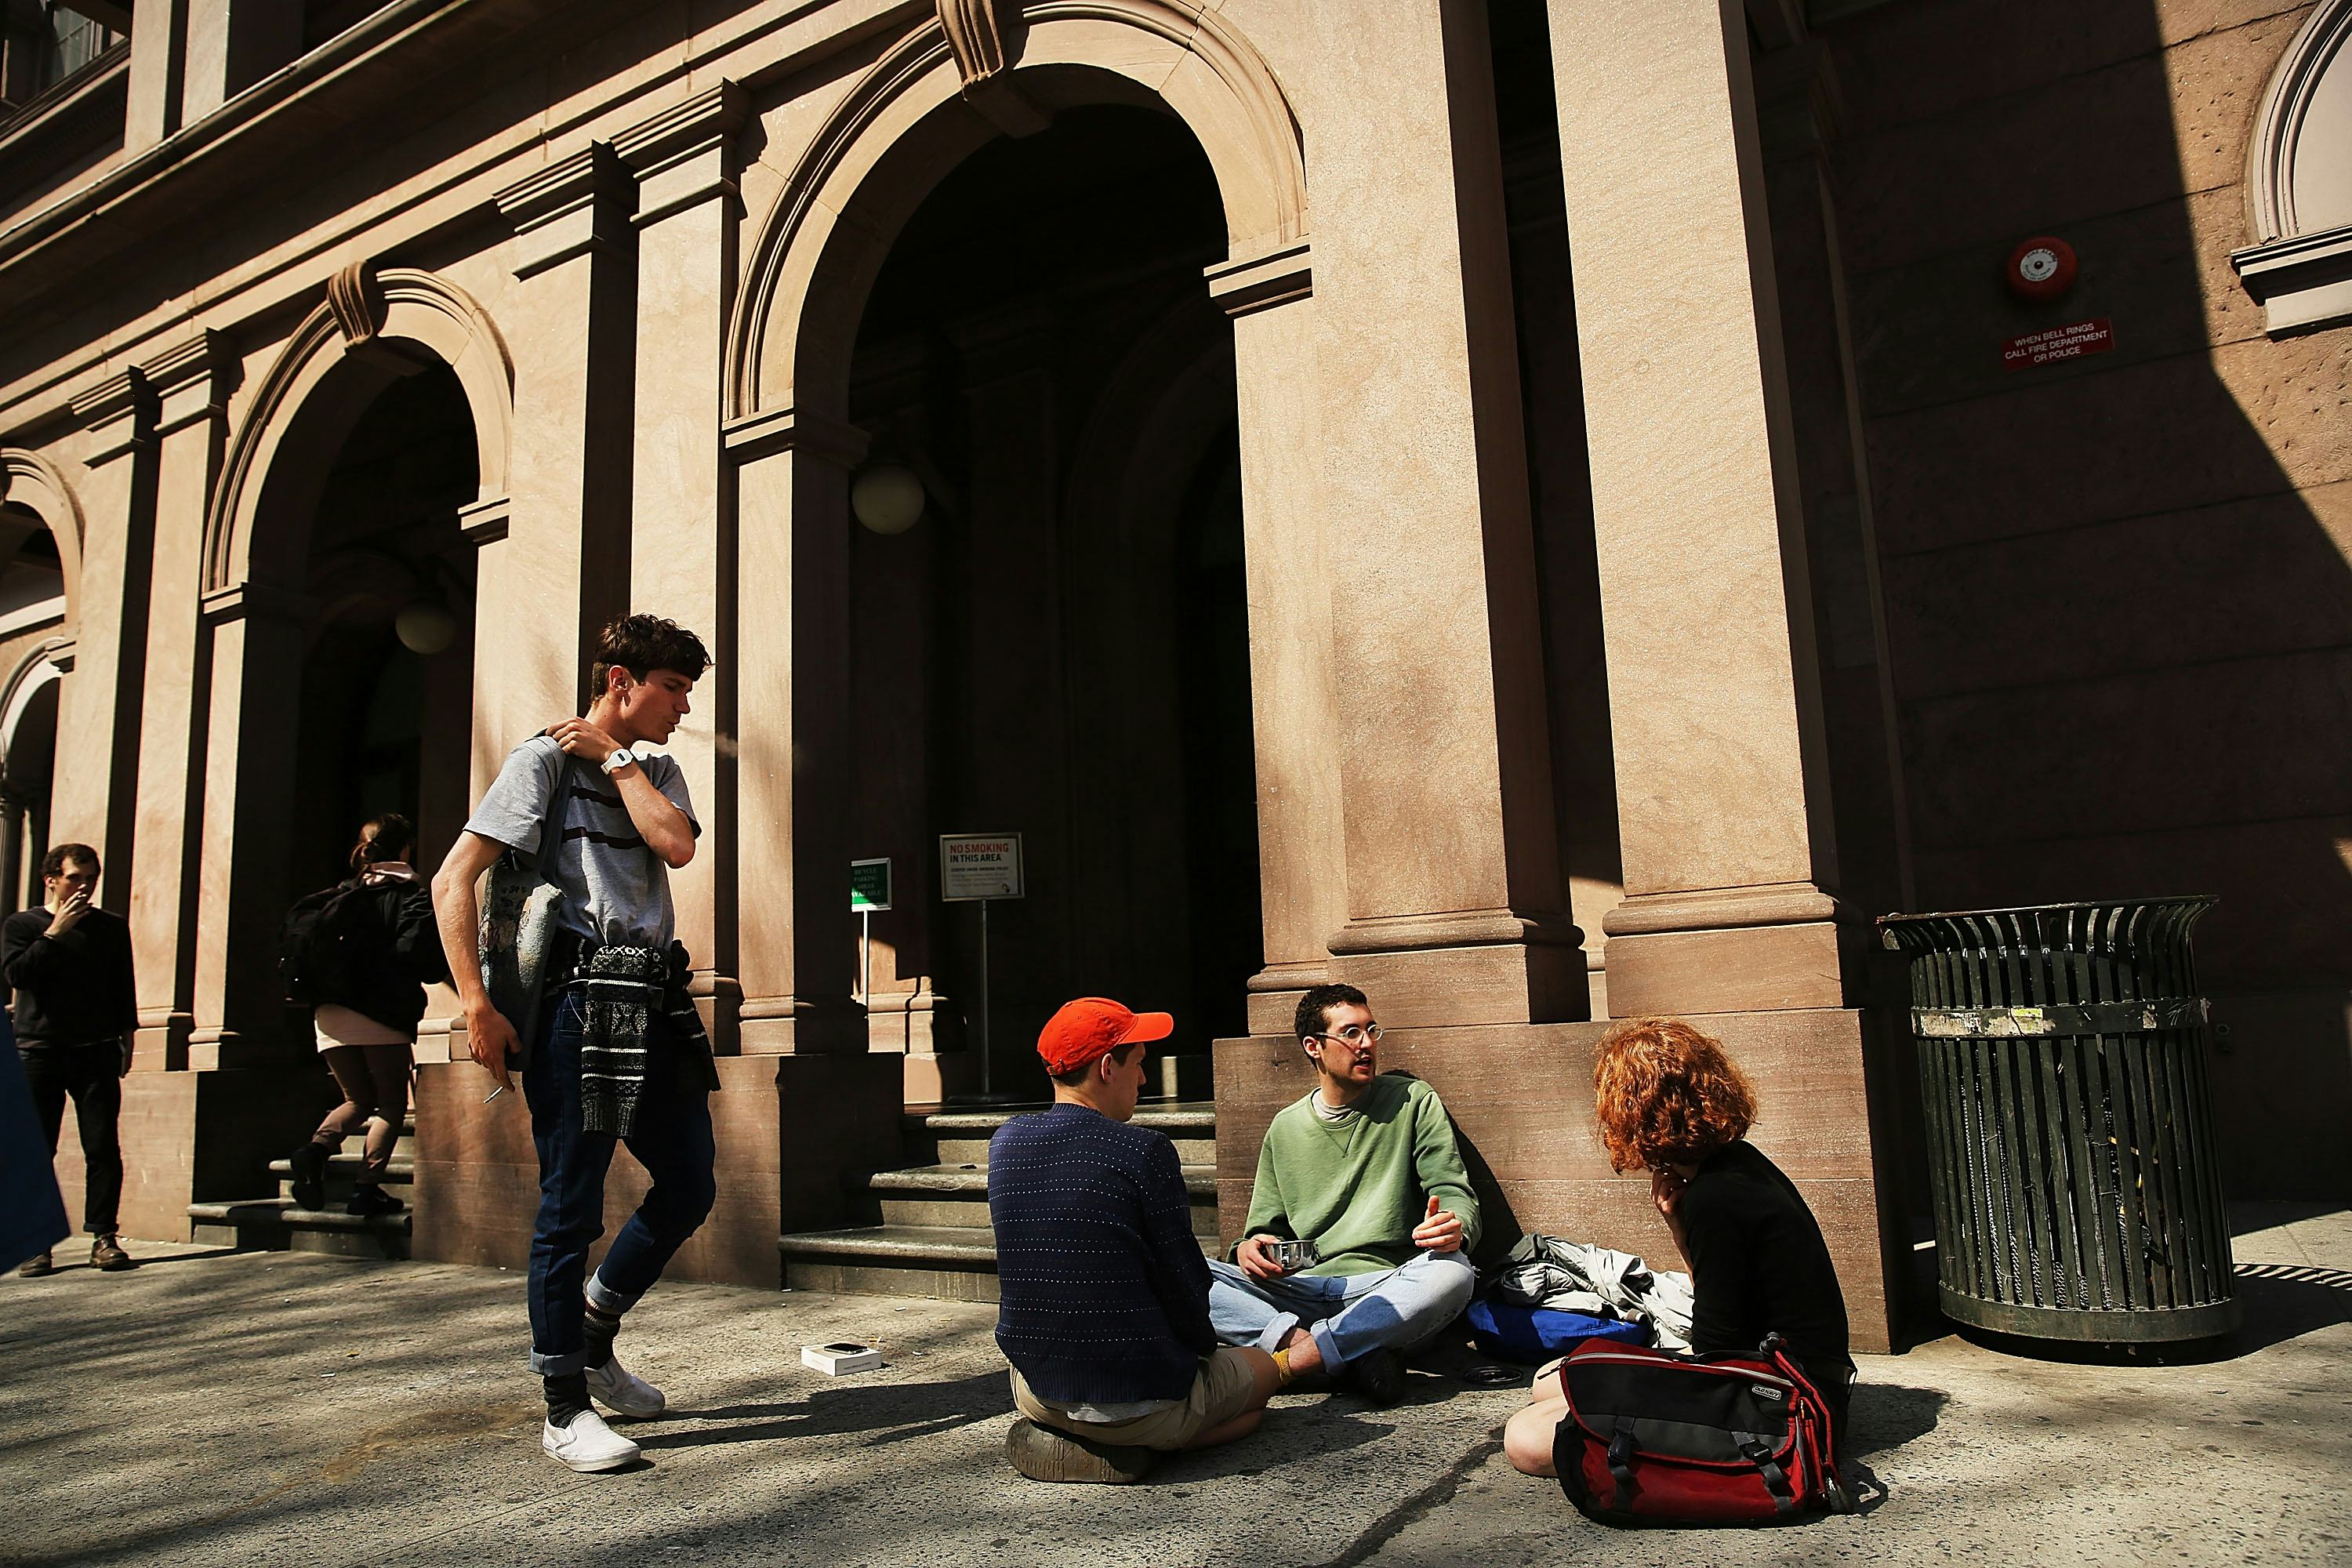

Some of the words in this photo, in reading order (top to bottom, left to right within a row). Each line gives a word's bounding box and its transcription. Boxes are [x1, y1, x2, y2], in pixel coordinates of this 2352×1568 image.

[2014, 335, 2042, 347] WHEN
[2043, 329, 2065, 341] BELL
[2067, 323, 2095, 336] RINGS
[2005, 348, 2027, 360] CALL
[2029, 343, 2048, 354] FIRE
[2049, 330, 2108, 350] DEPARTMENT
[2034, 353, 2047, 363] OR
[2049, 346, 2082, 359] POLICE
[950, 844, 964, 853] NO
[964, 843, 1009, 854] SMOKING
[949, 855, 959, 863] IN
[960, 854, 978, 862] THIS
[979, 853, 1001, 862] AREA
